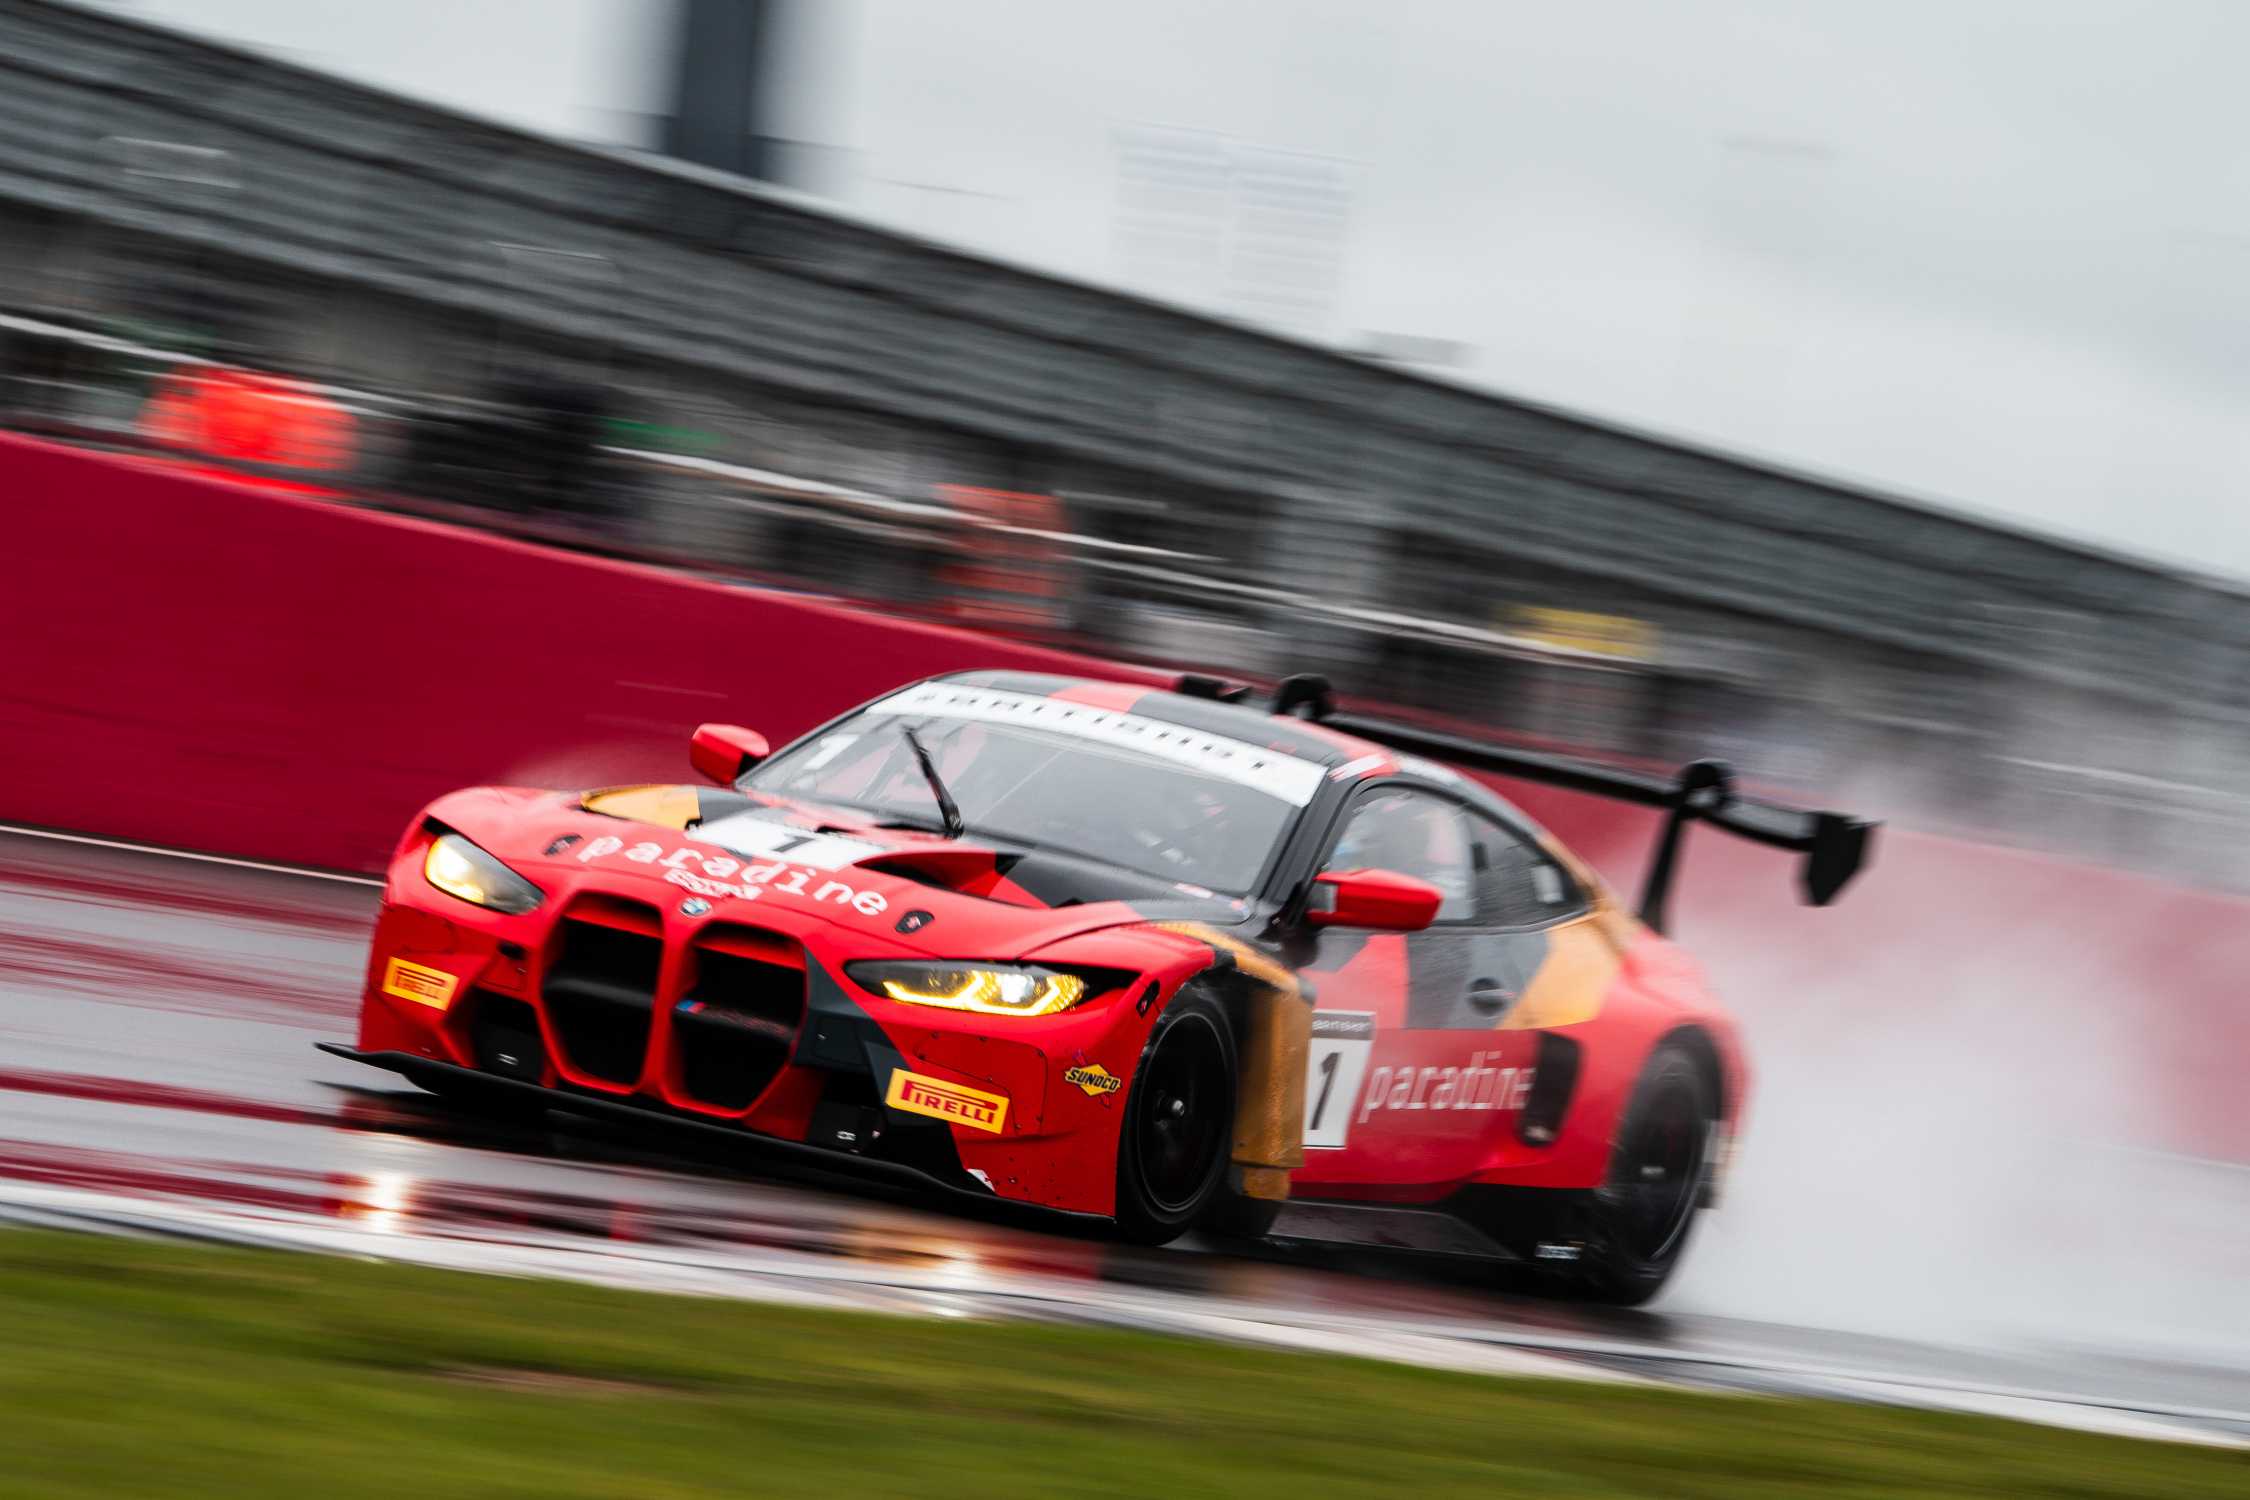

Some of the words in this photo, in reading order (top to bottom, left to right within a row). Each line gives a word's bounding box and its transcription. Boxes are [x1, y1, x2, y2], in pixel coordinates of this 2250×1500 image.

[772, 835, 815, 853] 1
[577, 836, 888, 916] paradine
[901, 1080, 998, 1123] PIRELLI
[1067, 1069, 1119, 1091] SUNOCO
[1310, 1052, 1342, 1130] 1
[1358, 1050, 1536, 1124] paradine
